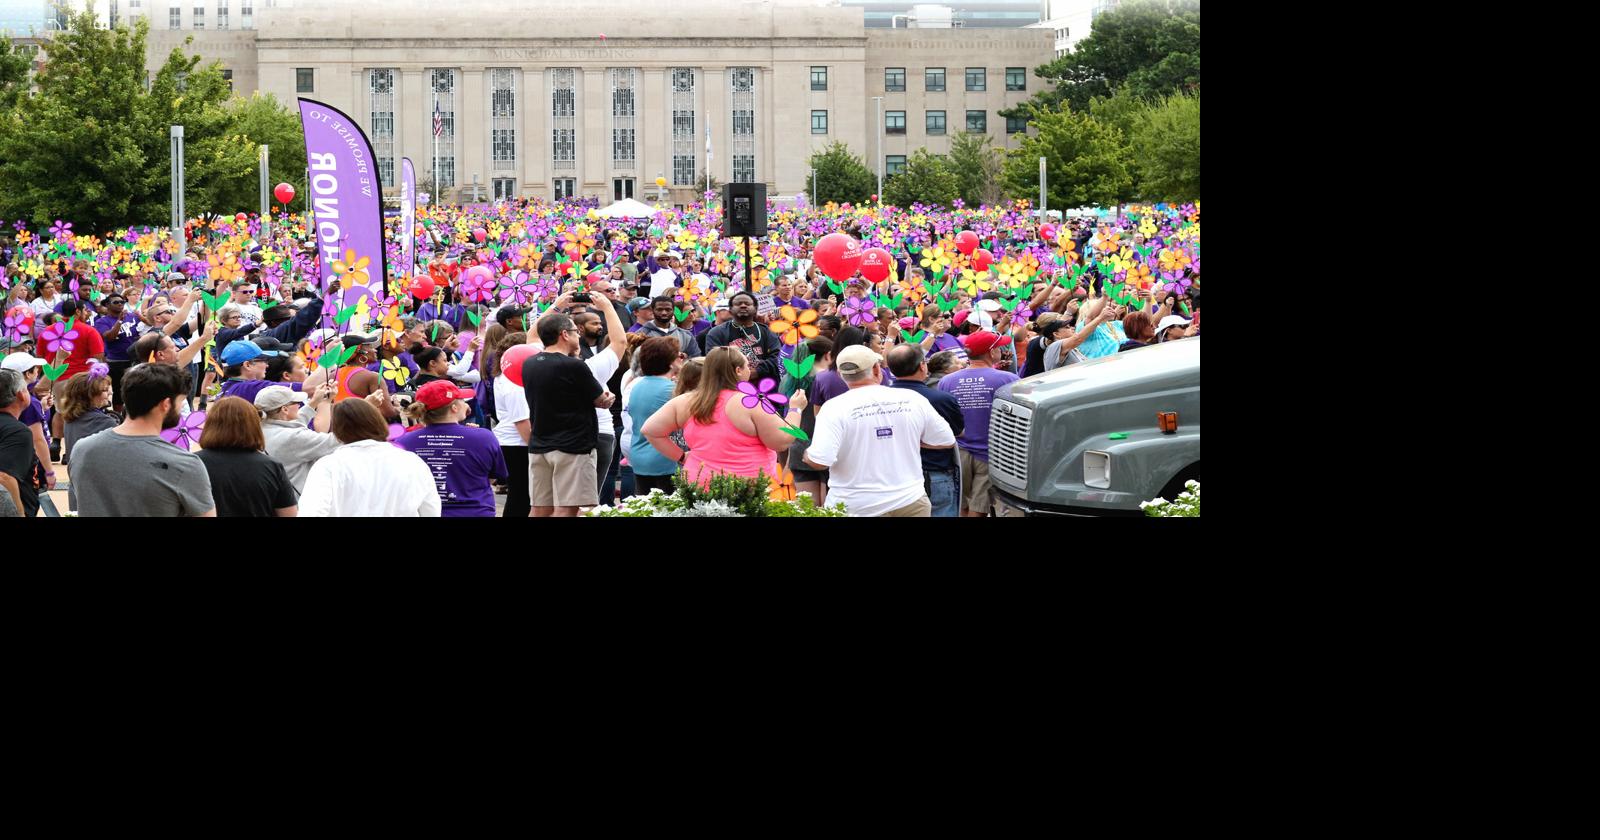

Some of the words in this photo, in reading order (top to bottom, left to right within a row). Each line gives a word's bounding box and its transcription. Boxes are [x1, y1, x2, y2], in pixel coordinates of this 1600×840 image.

[491, 49, 565, 59] MUNICIPAL
[570, 49, 634, 59] BUILDING
[958, 376, 985, 384] 2016
